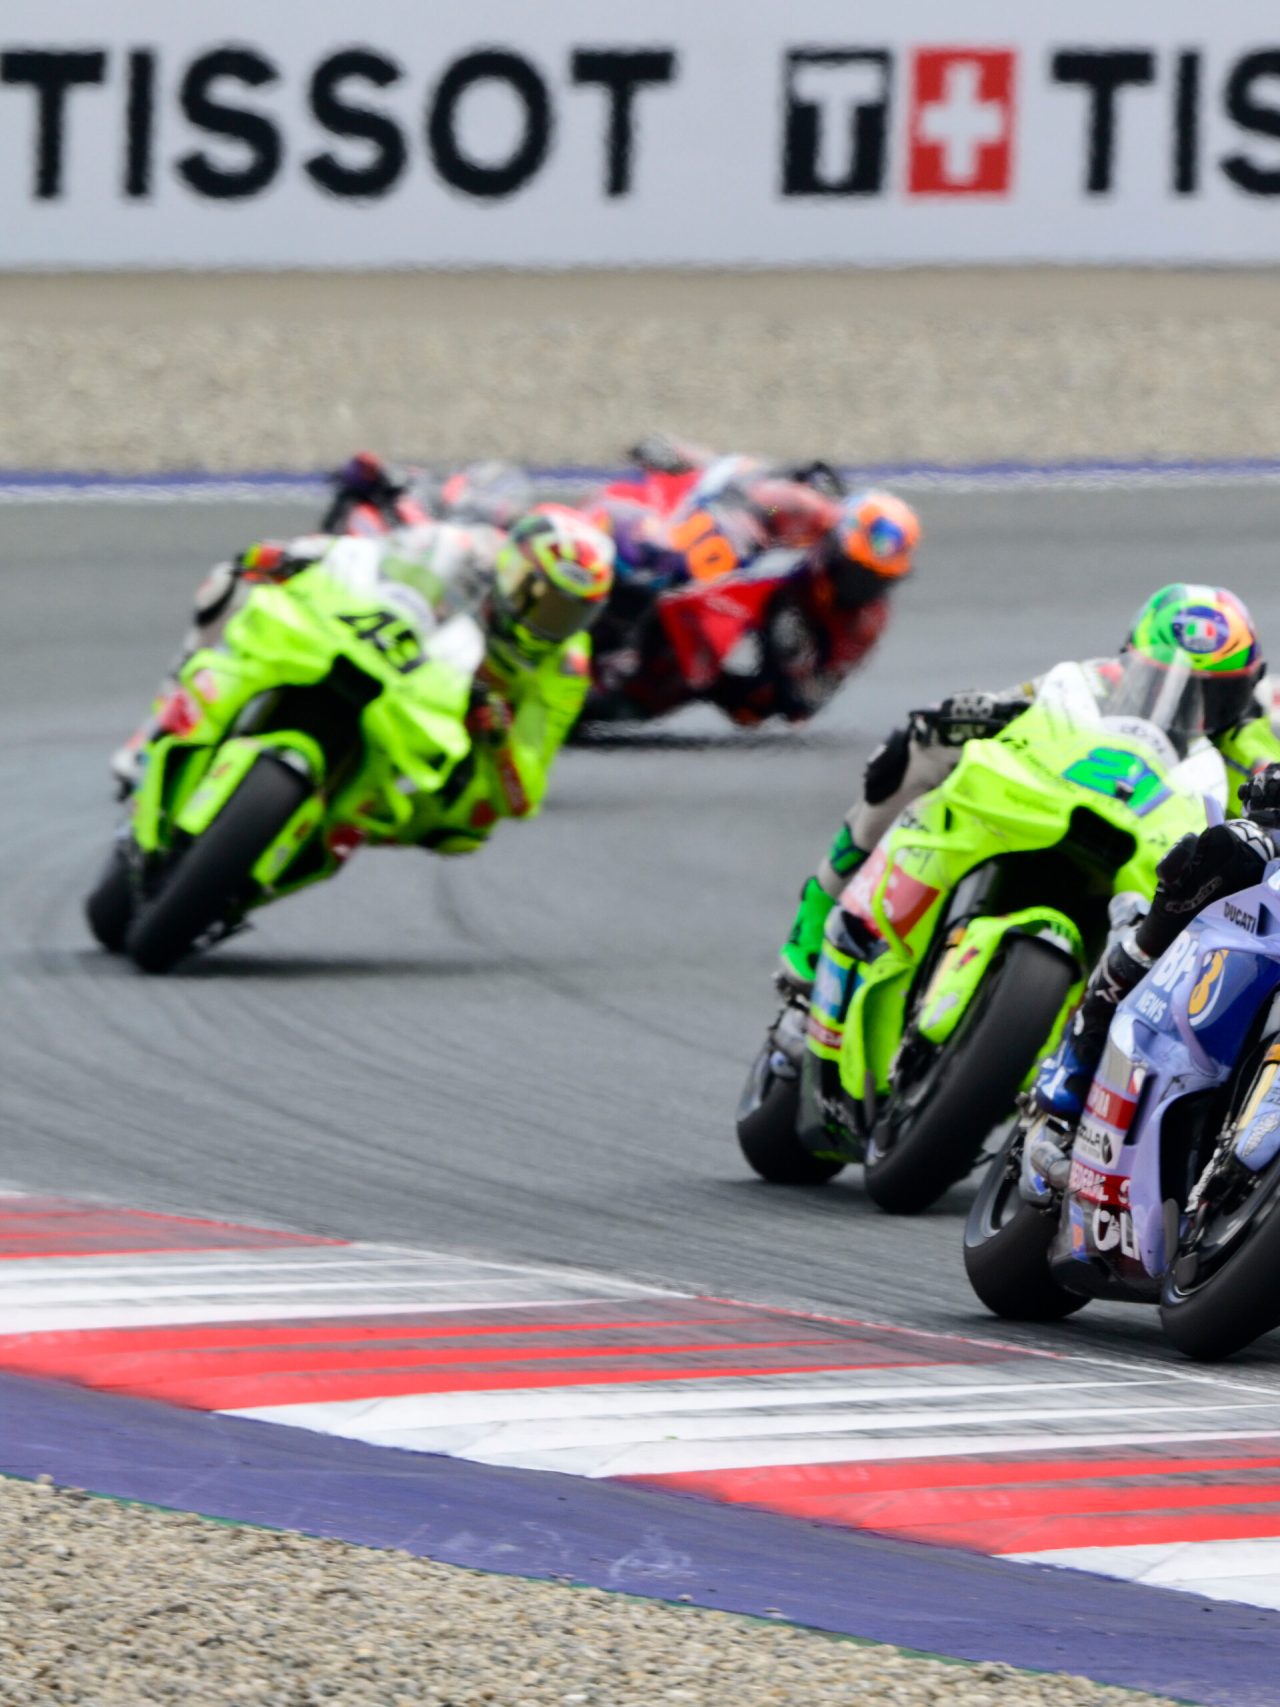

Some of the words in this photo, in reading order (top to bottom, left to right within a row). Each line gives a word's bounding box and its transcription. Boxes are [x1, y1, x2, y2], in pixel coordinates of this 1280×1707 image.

[0, 46, 676, 200] TISSOT
[1223, 901, 1257, 935] DUCATI
[1134, 990, 1168, 1024] NEWS
